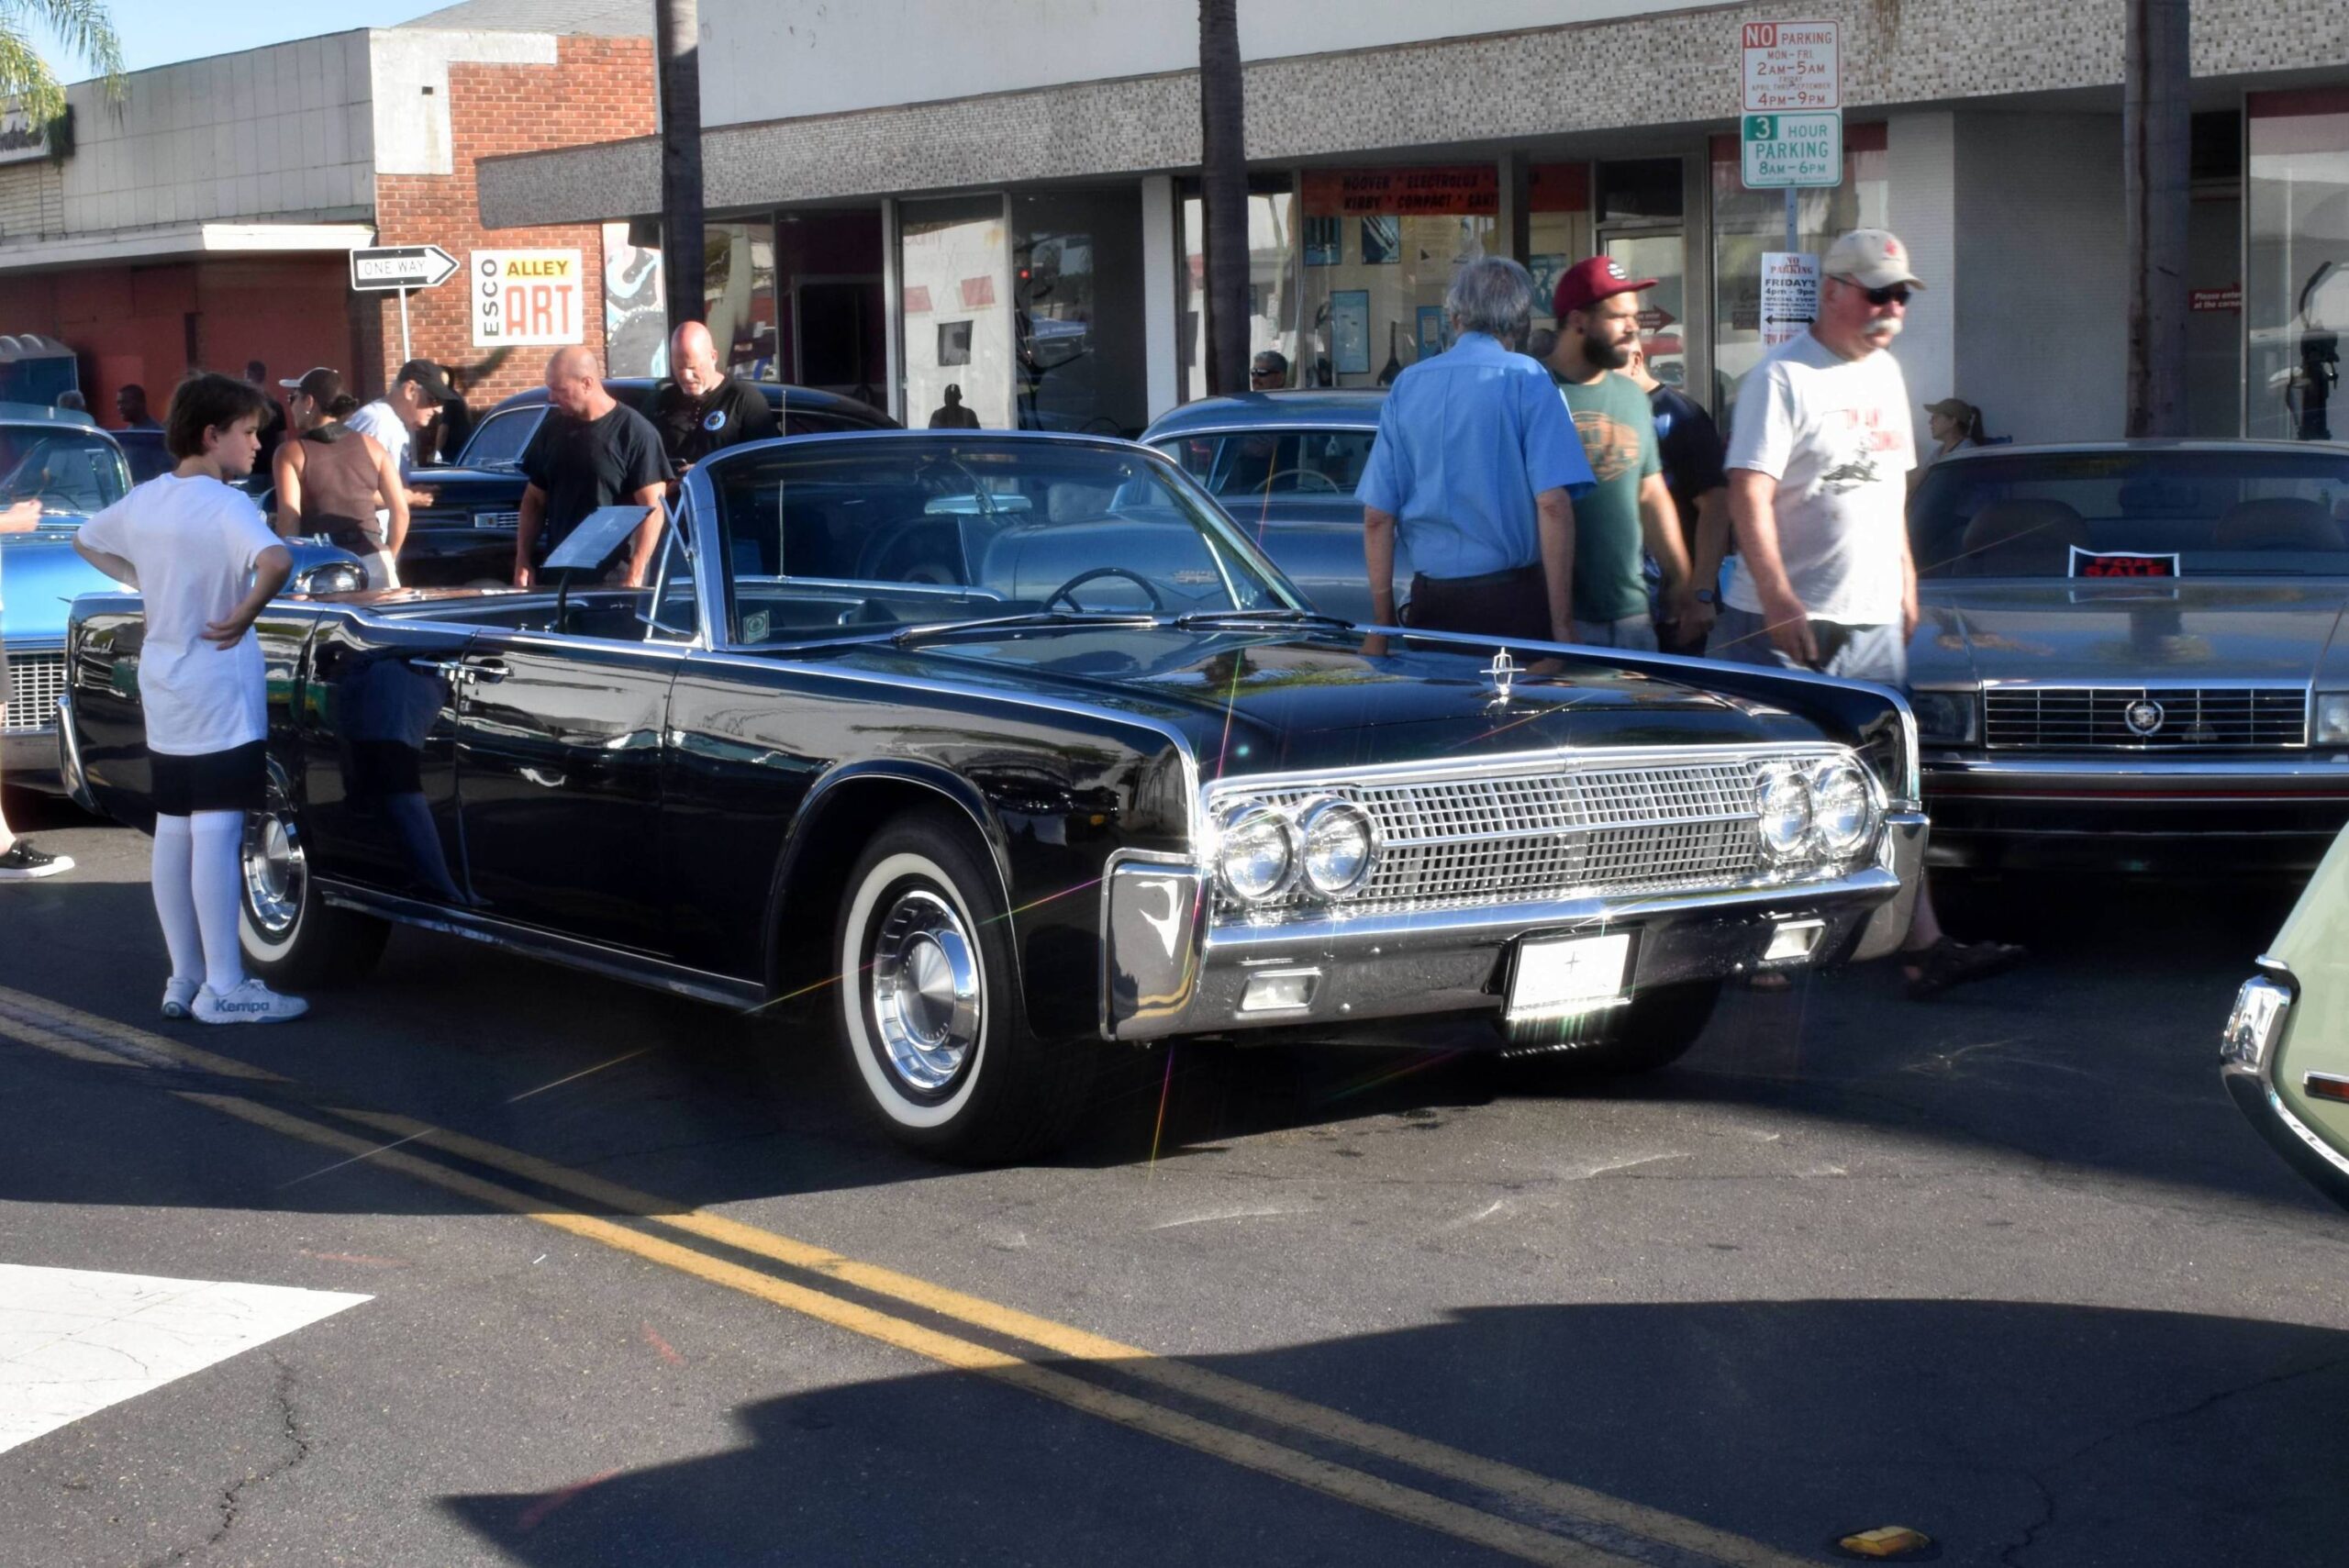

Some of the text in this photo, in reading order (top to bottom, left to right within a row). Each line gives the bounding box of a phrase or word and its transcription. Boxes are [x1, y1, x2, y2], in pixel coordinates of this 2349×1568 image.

[1746, 25, 1832, 47] NO PARKING
[1755, 117, 1828, 139] 3 HOUR
[1755, 141, 1829, 159] PARKING
[1343, 176, 1389, 190] HOOVER
[1344, 195, 1382, 210] KIRBY
[1397, 194, 1452, 209] COMPACT
[364, 260, 425, 275] ONE WAY
[507, 261, 568, 276] ALLEY
[481, 259, 499, 337] ESCO
[505, 284, 573, 336] ART
[2084, 564, 2166, 577] SALE
[214, 998, 270, 1013] Kempa
